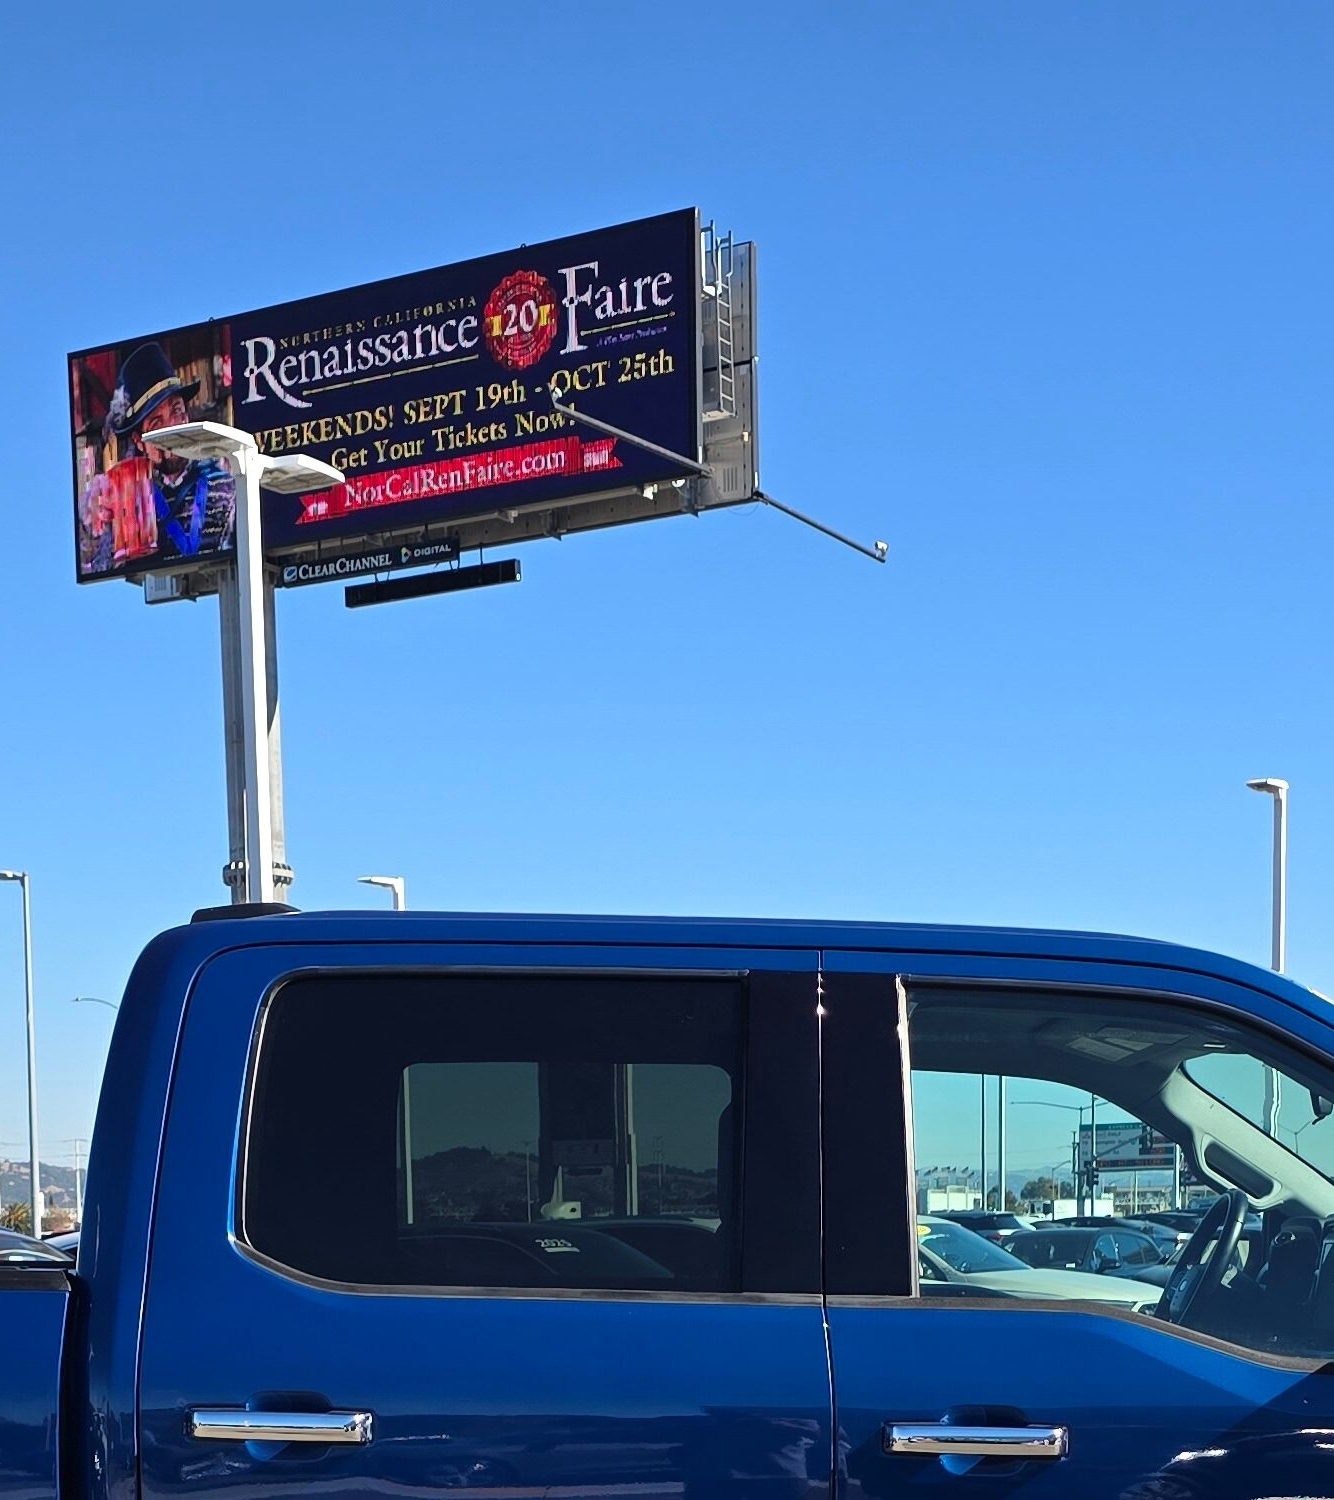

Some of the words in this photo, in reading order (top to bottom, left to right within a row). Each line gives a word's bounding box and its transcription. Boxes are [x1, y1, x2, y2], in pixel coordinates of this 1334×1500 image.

[240, 314, 480, 409] Renaissance
[557, 260, 674, 355] Faire
[278, 320, 366, 350] NORTHERN
[373, 295, 478, 328] CALIFORNIA
[503, 299, 539, 336] 20
[403, 389, 467, 425] SEPT
[475, 378, 527, 412] 19th
[551, 359, 612, 395] OCT
[617, 348, 675, 384] 25th
[331, 446, 368, 471] Get
[372, 438, 425, 464] Your
[432, 421, 508, 452] Tickets
[514, 402, 576, 438] Now!
[344, 448, 566, 509] NorCalRenFaire.com
[413, 543, 452, 558] DIGITAL
